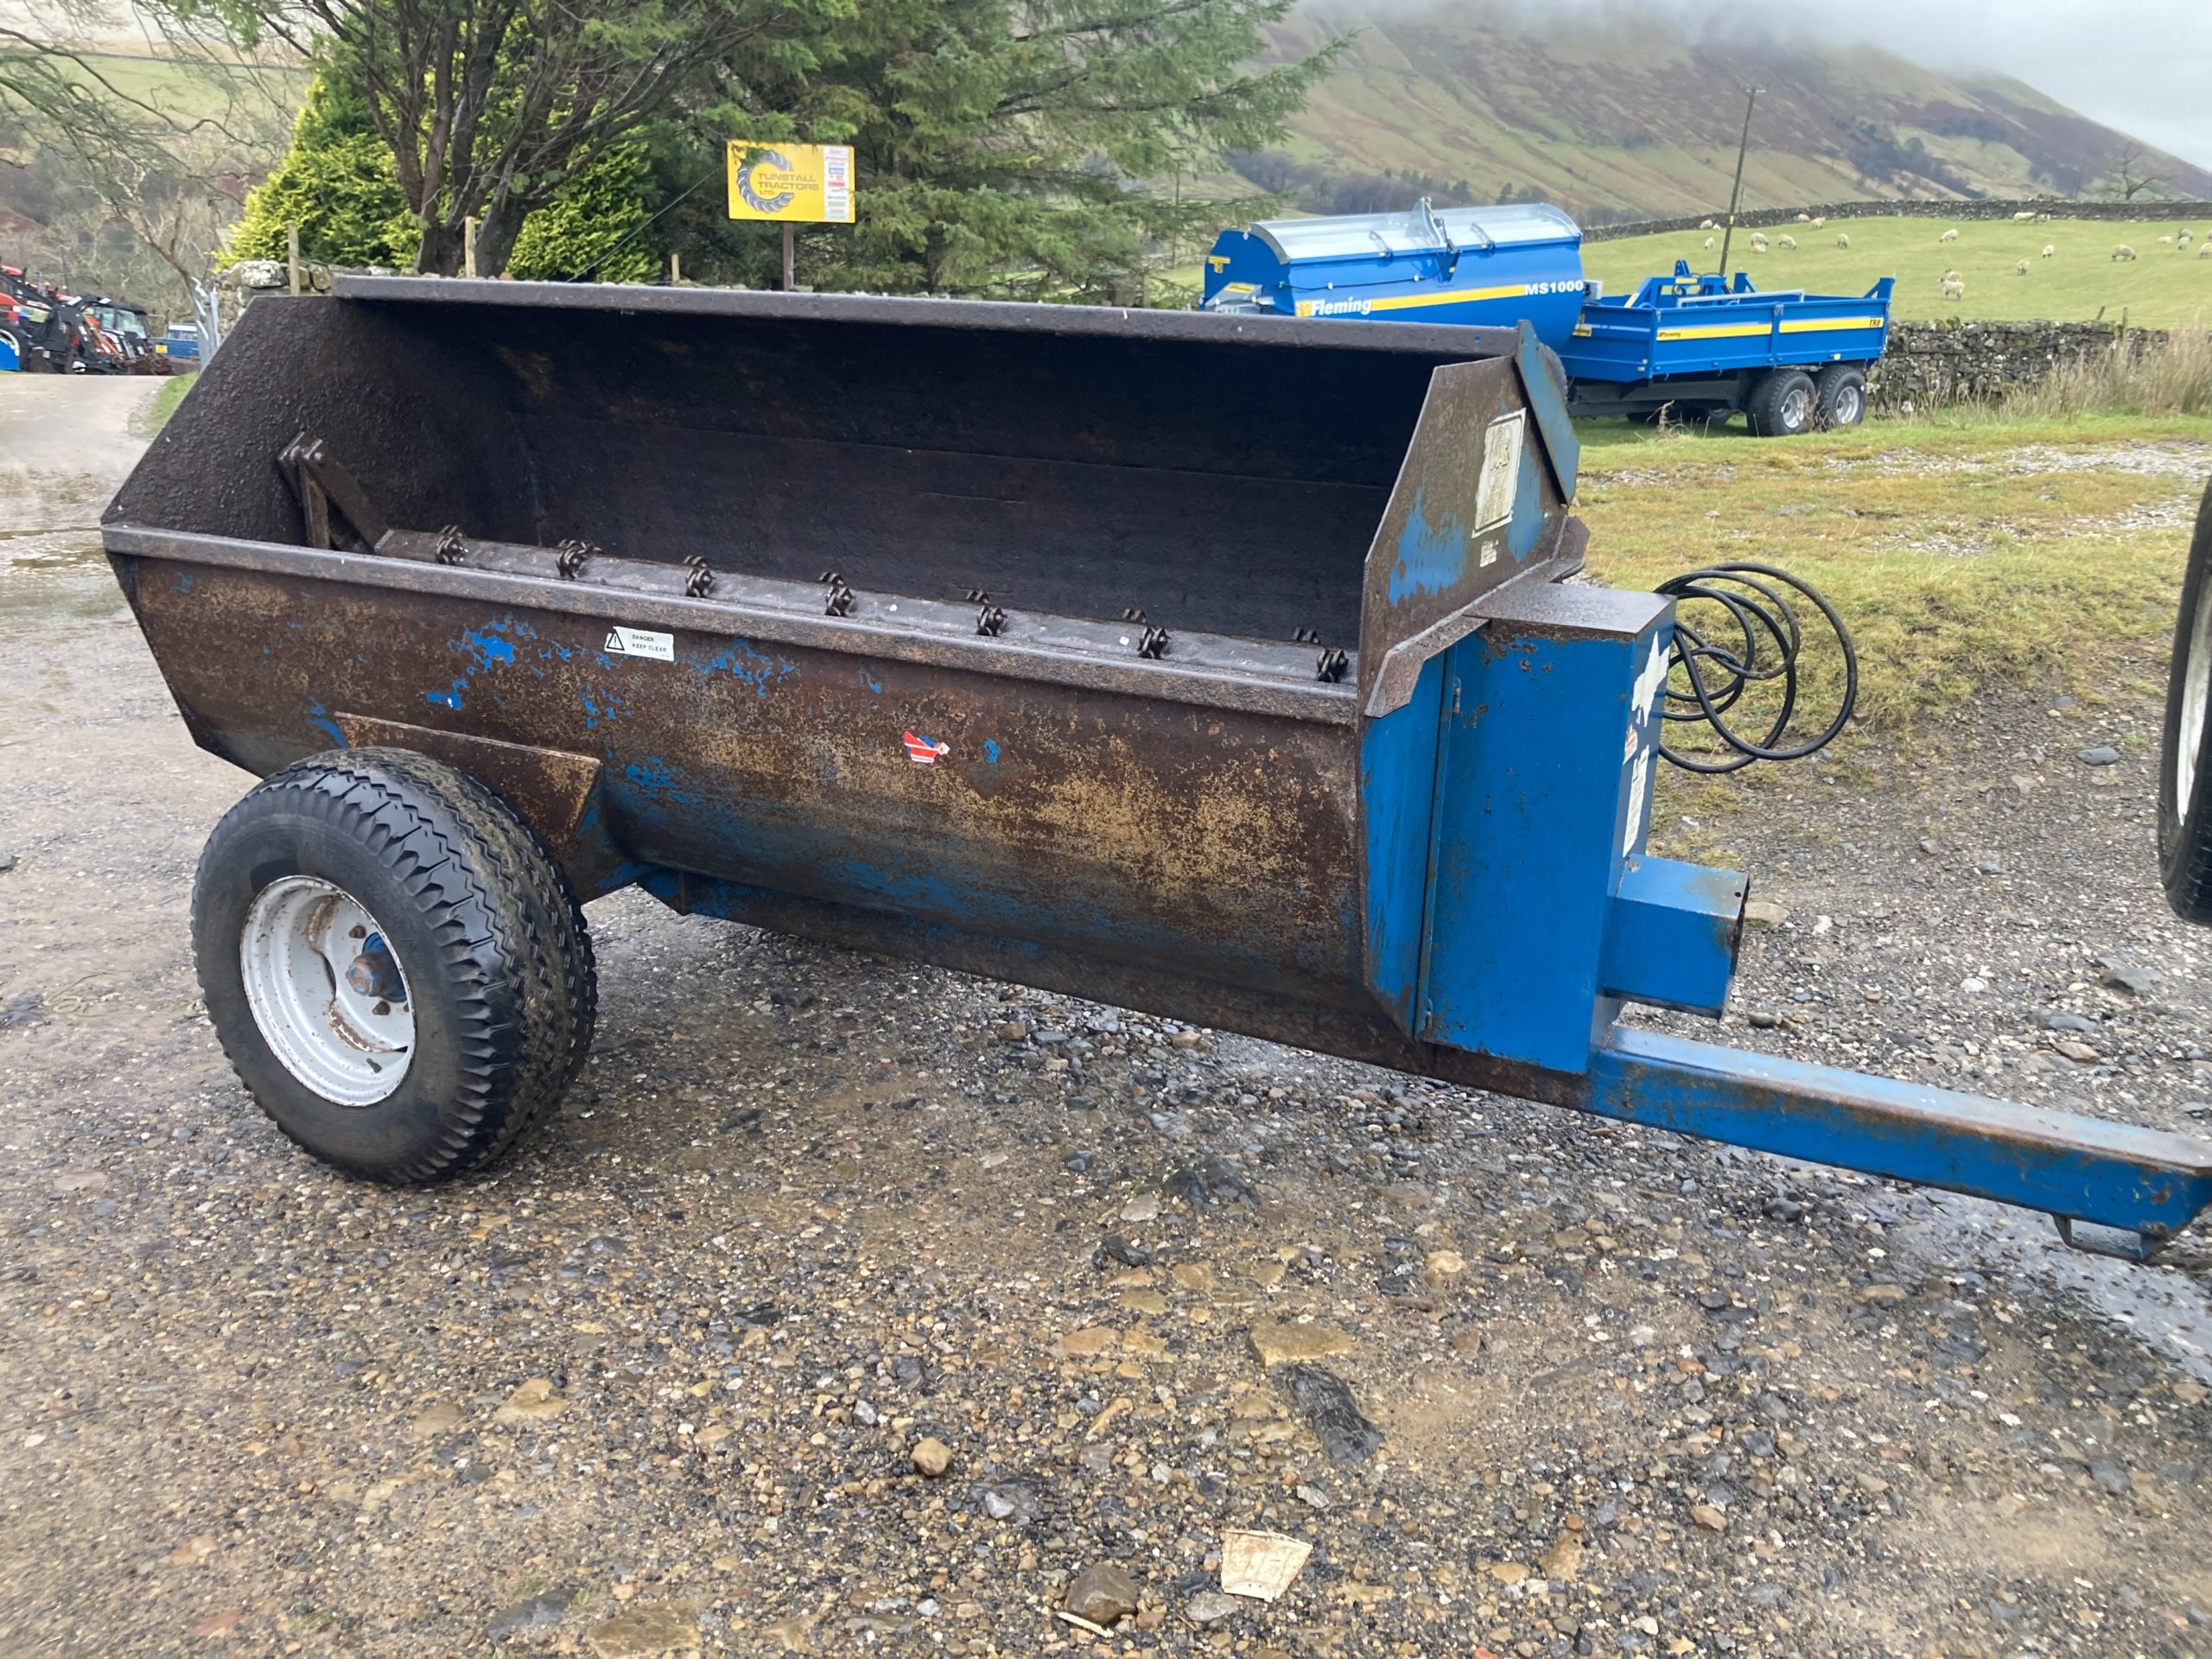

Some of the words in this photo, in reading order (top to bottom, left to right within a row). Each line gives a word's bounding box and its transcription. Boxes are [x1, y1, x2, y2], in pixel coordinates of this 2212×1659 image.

[758, 173, 817, 182] TUNSTALL
[758, 181, 820, 191] TRACTORS
[1525, 280, 1583, 296] MS1000
[1311, 296, 1371, 316] Fleming
